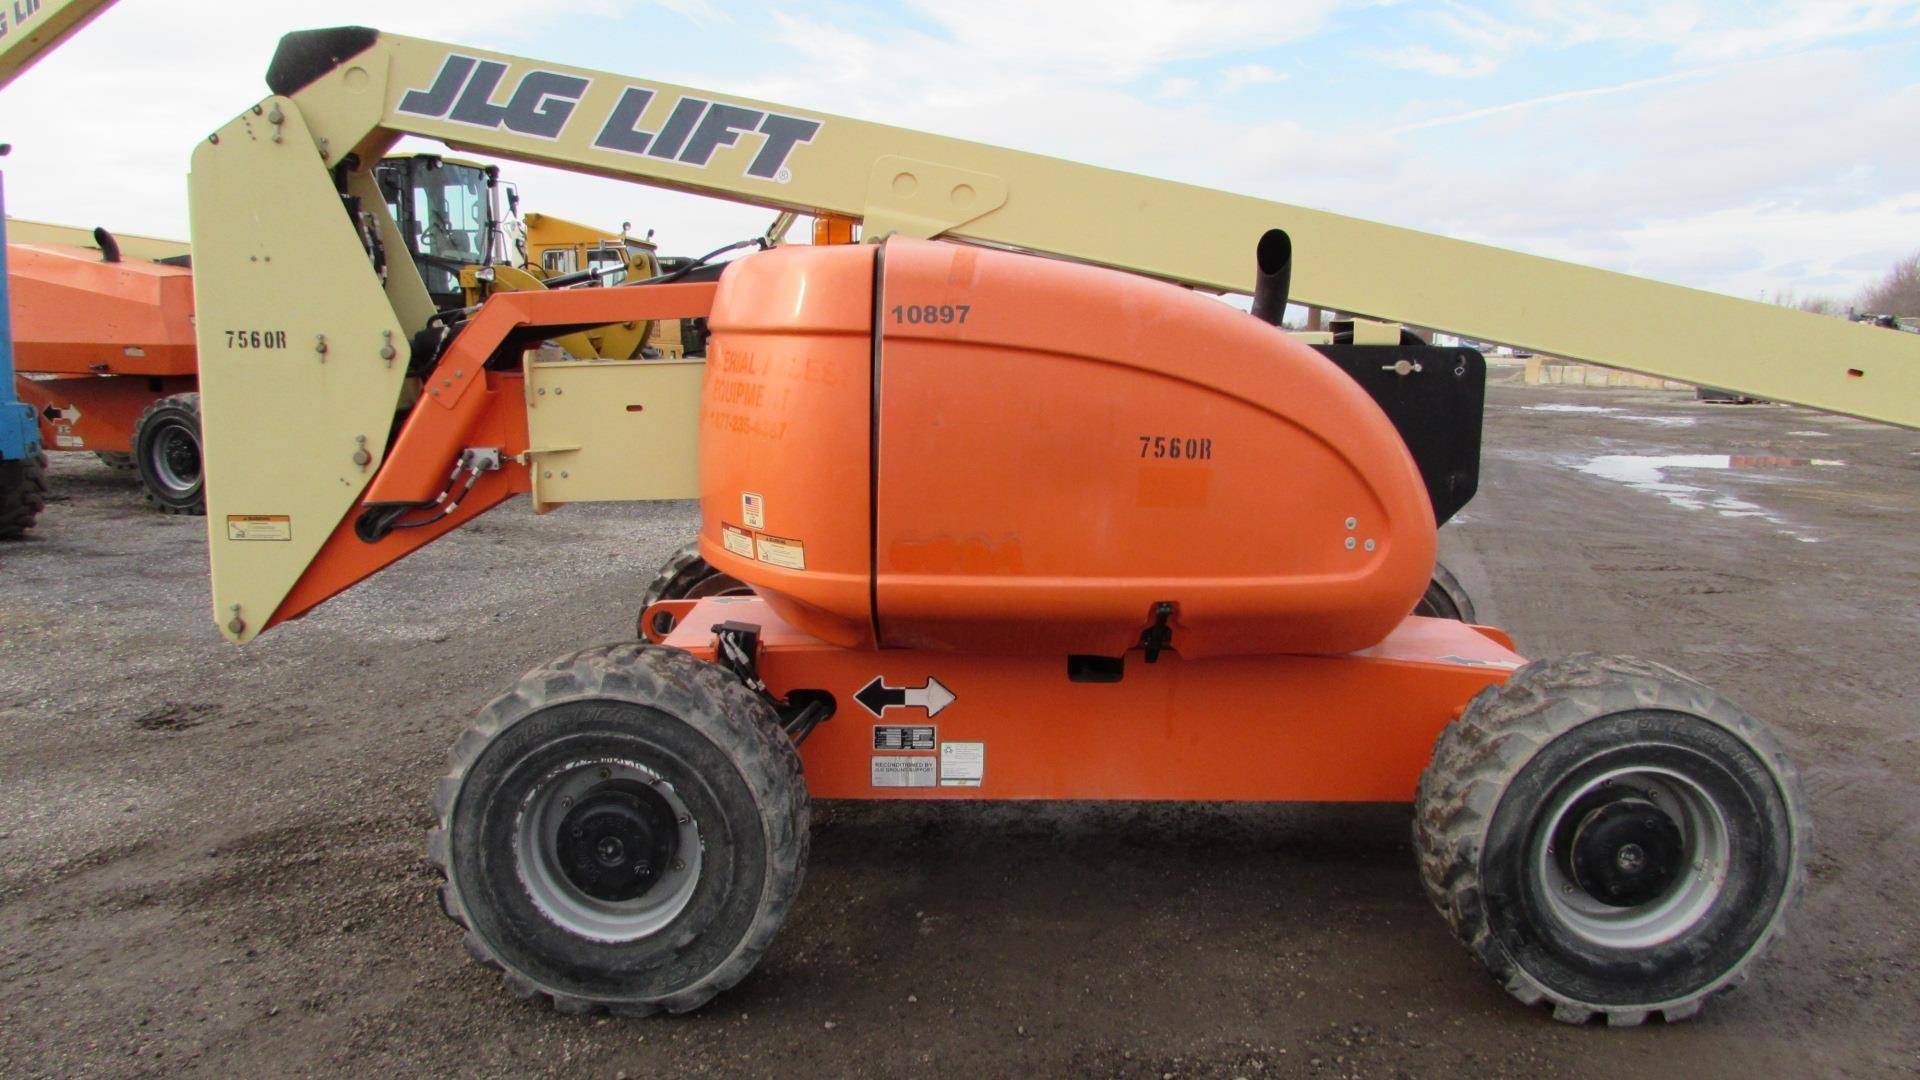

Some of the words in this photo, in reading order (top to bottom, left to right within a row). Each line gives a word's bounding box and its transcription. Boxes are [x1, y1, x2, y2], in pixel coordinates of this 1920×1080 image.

[397, 54, 592, 140] JLG
[593, 86, 823, 180] LIFT
[892, 305, 970, 324] 10897
[225, 330, 286, 349] 7560R
[1139, 436, 1212, 460] 7560R
